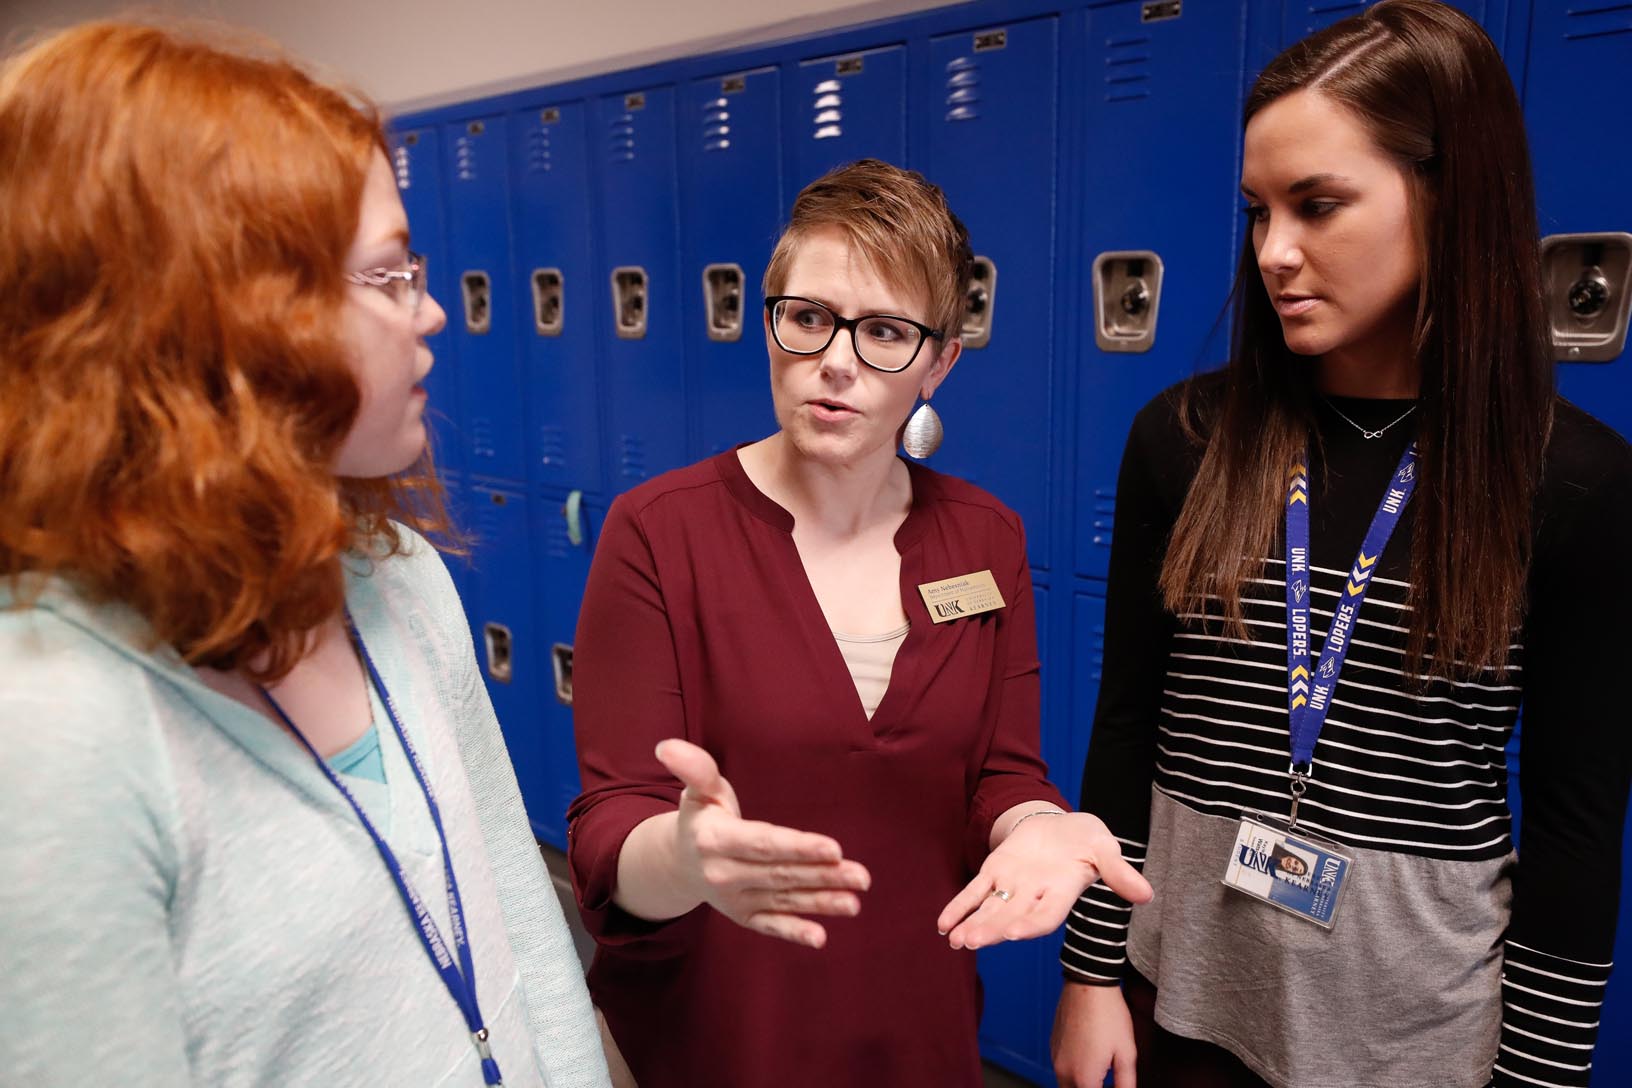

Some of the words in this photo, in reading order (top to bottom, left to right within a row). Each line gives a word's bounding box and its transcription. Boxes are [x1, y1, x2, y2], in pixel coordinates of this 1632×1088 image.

[1382, 488, 1405, 514] UNK
[1291, 547, 1306, 572] UNK
[934, 600, 965, 617] UNK
[1292, 608, 1307, 656] LOPERS
[1310, 684, 1329, 710] UNK
[1328, 604, 1354, 653] LOPERS
[1320, 858, 1340, 887] UNK
